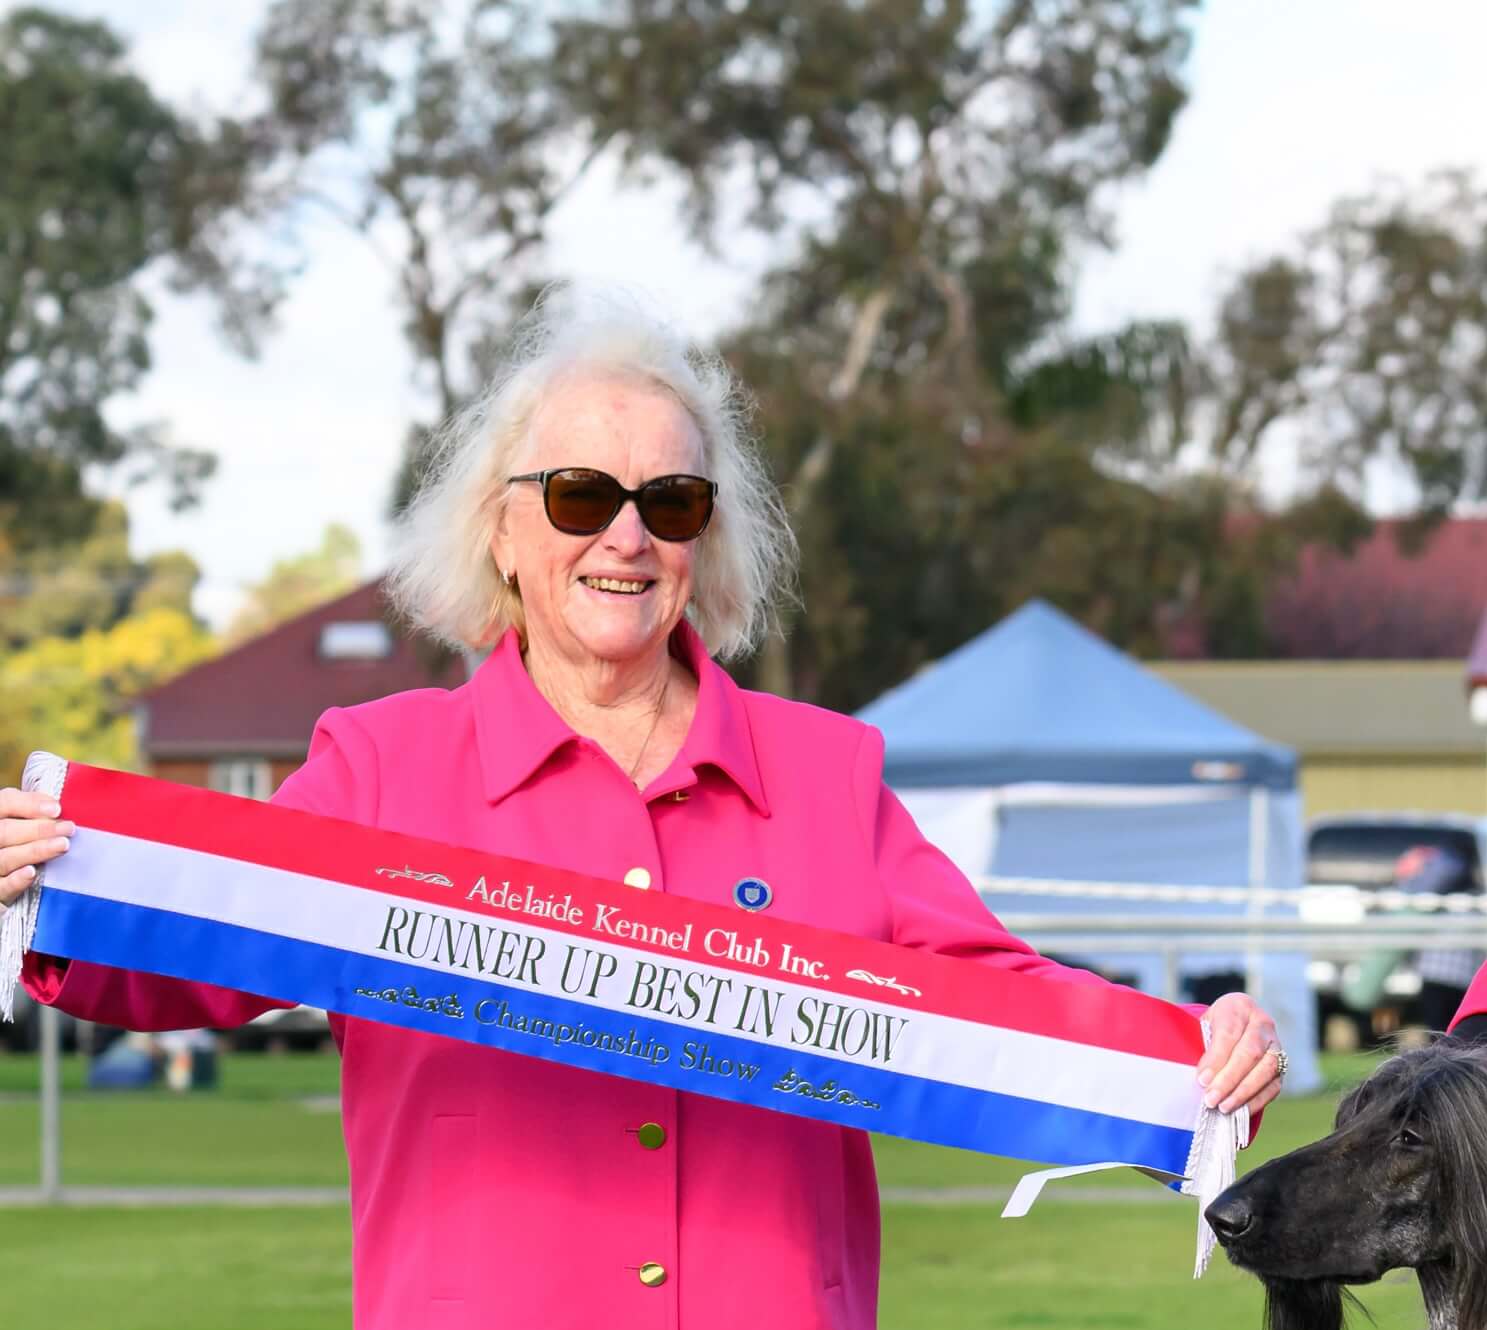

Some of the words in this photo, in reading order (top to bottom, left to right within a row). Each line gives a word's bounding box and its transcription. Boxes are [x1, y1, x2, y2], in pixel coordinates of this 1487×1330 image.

[465, 876, 584, 926] Adelaide
[592, 902, 693, 952] Kennel
[703, 928, 770, 968] Club
[778, 943, 831, 981] Inc.
[376, 905, 546, 986] RUNNER
[561, 945, 618, 999] UP
[625, 960, 733, 1025] BEST
[733, 985, 786, 1038] IN
[791, 996, 910, 1065] SHOW
[474, 998, 671, 1065] Championship
[679, 1041, 762, 1083] Show
